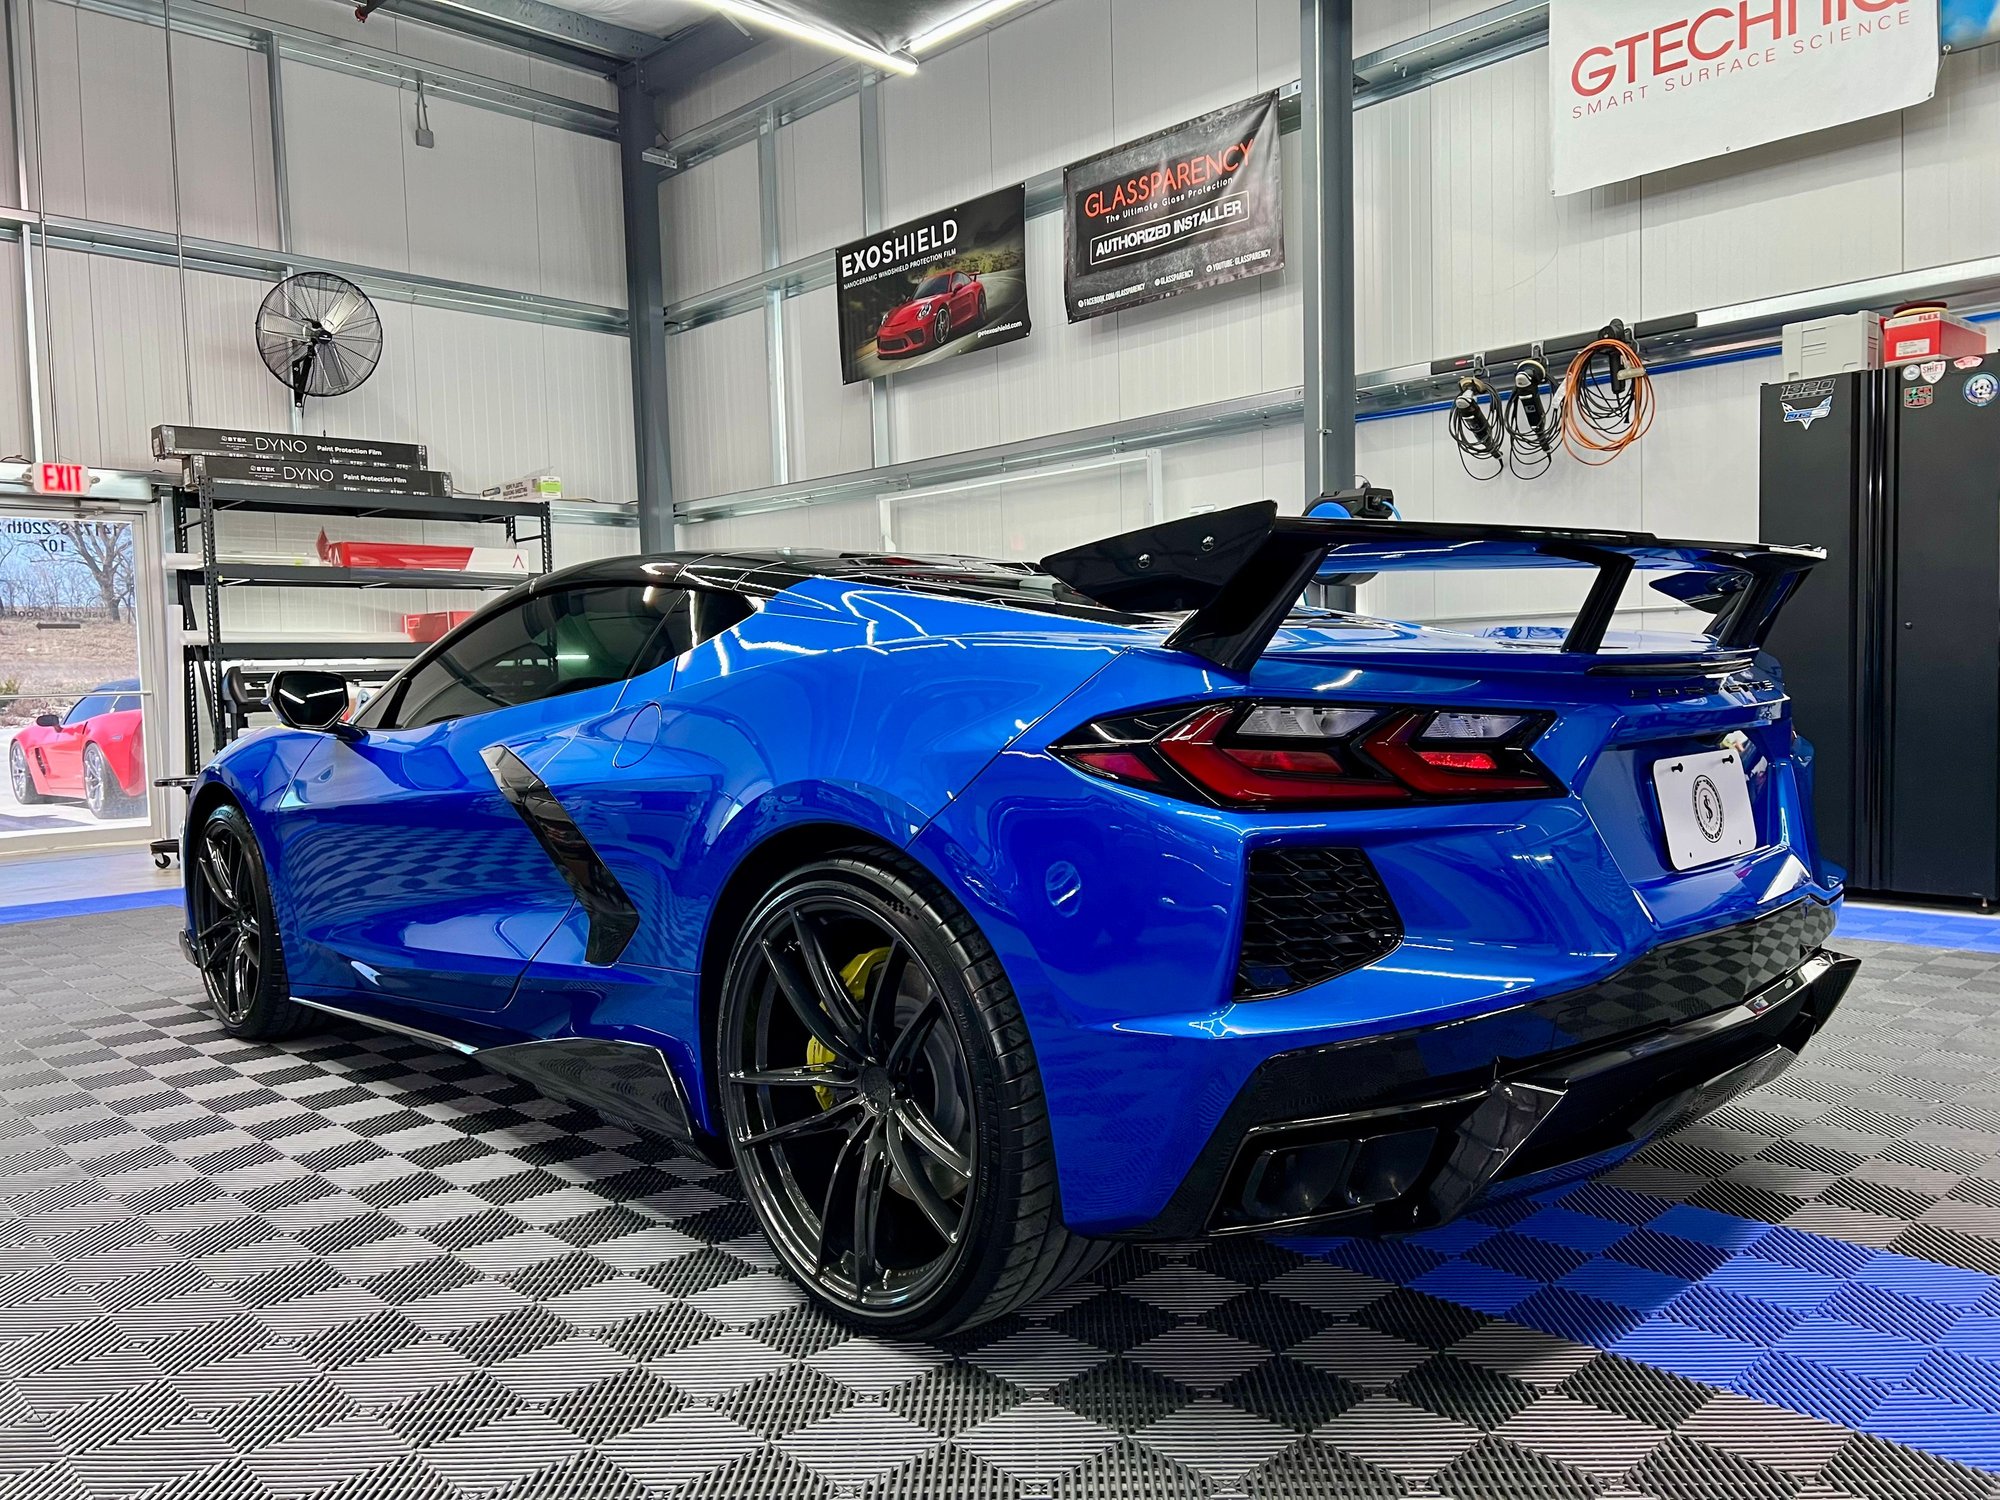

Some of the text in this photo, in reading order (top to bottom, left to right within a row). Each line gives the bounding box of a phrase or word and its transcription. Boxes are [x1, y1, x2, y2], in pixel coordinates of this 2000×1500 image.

[1572, 9, 1910, 119] SMART SURFACE SCIENCE
[1084, 138, 1256, 218] GLASSPARENCY
[1105, 176, 1233, 224] The Ultimate Glass Protection
[1095, 200, 1242, 257] AUTHORIZED INSTALLER
[841, 219, 958, 278] EXOSHIELD
[843, 248, 957, 290] NANOCERAMIC WINDSHIELD PROTECTION FILM
[1918, 312, 1939, 321] FLEX
[1922, 363, 1944, 374] SHIFT
[255, 437, 308, 453] DYNO
[316, 445, 334, 453] Paint
[334, 446, 368, 456] Protection
[43, 464, 82, 491] EXIT
[283, 466, 334, 482] DYNO
[343, 473, 407, 484] Paint Protection Film
